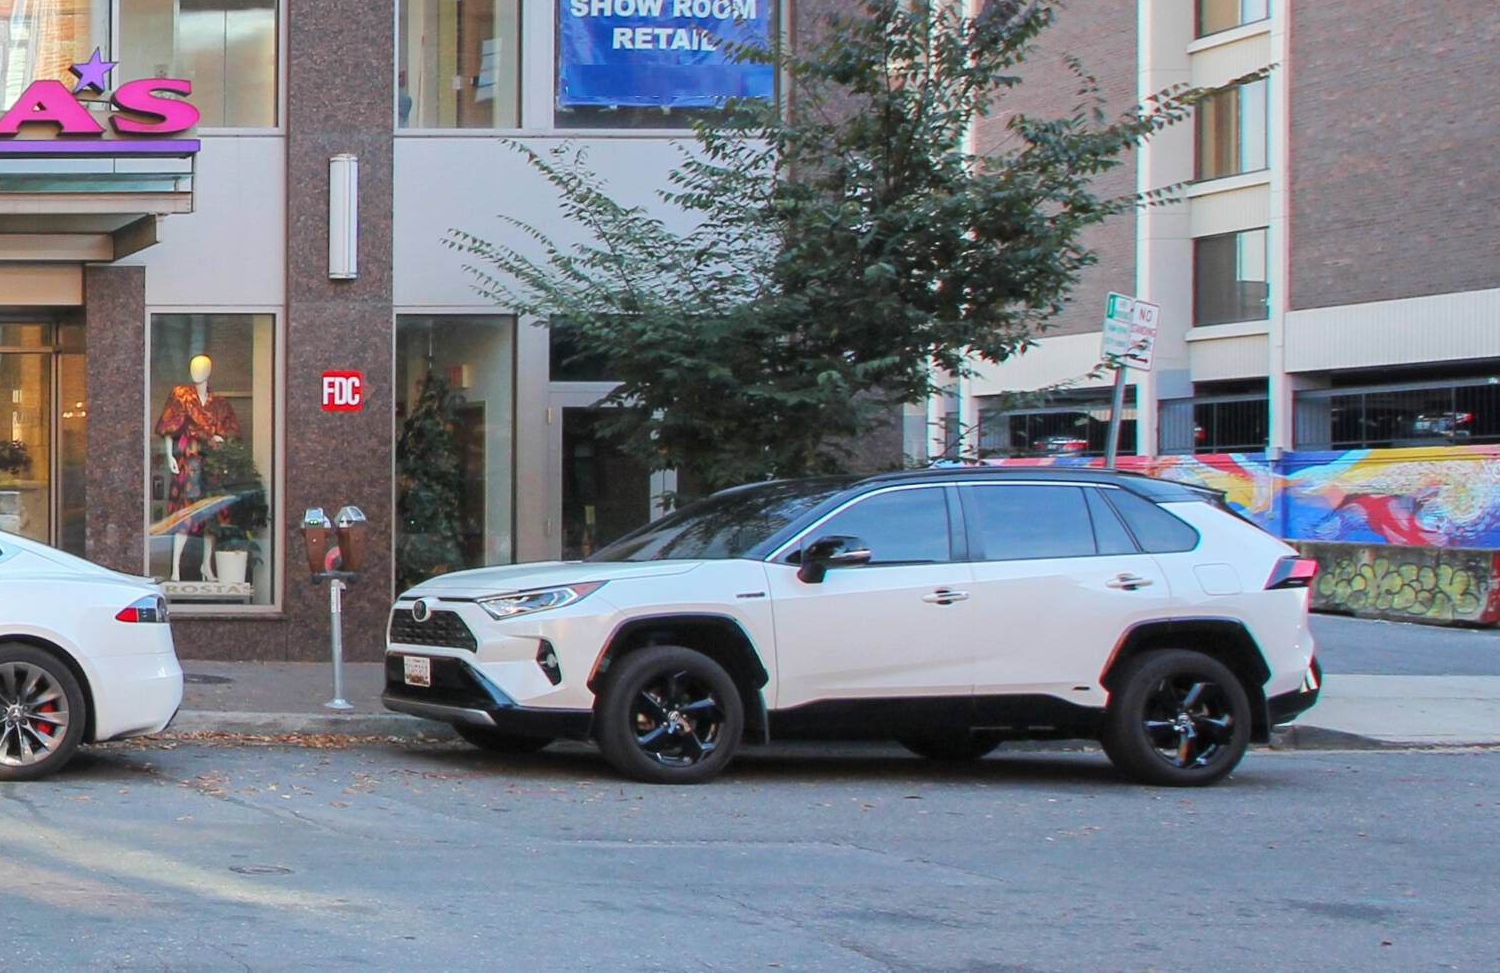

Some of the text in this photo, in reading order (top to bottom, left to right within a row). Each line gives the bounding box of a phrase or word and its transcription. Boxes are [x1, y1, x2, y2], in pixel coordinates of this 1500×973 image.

[611, 27, 718, 52] RETAIL
[1139, 308, 1153, 323] NO
[322, 376, 361, 406] FDC
